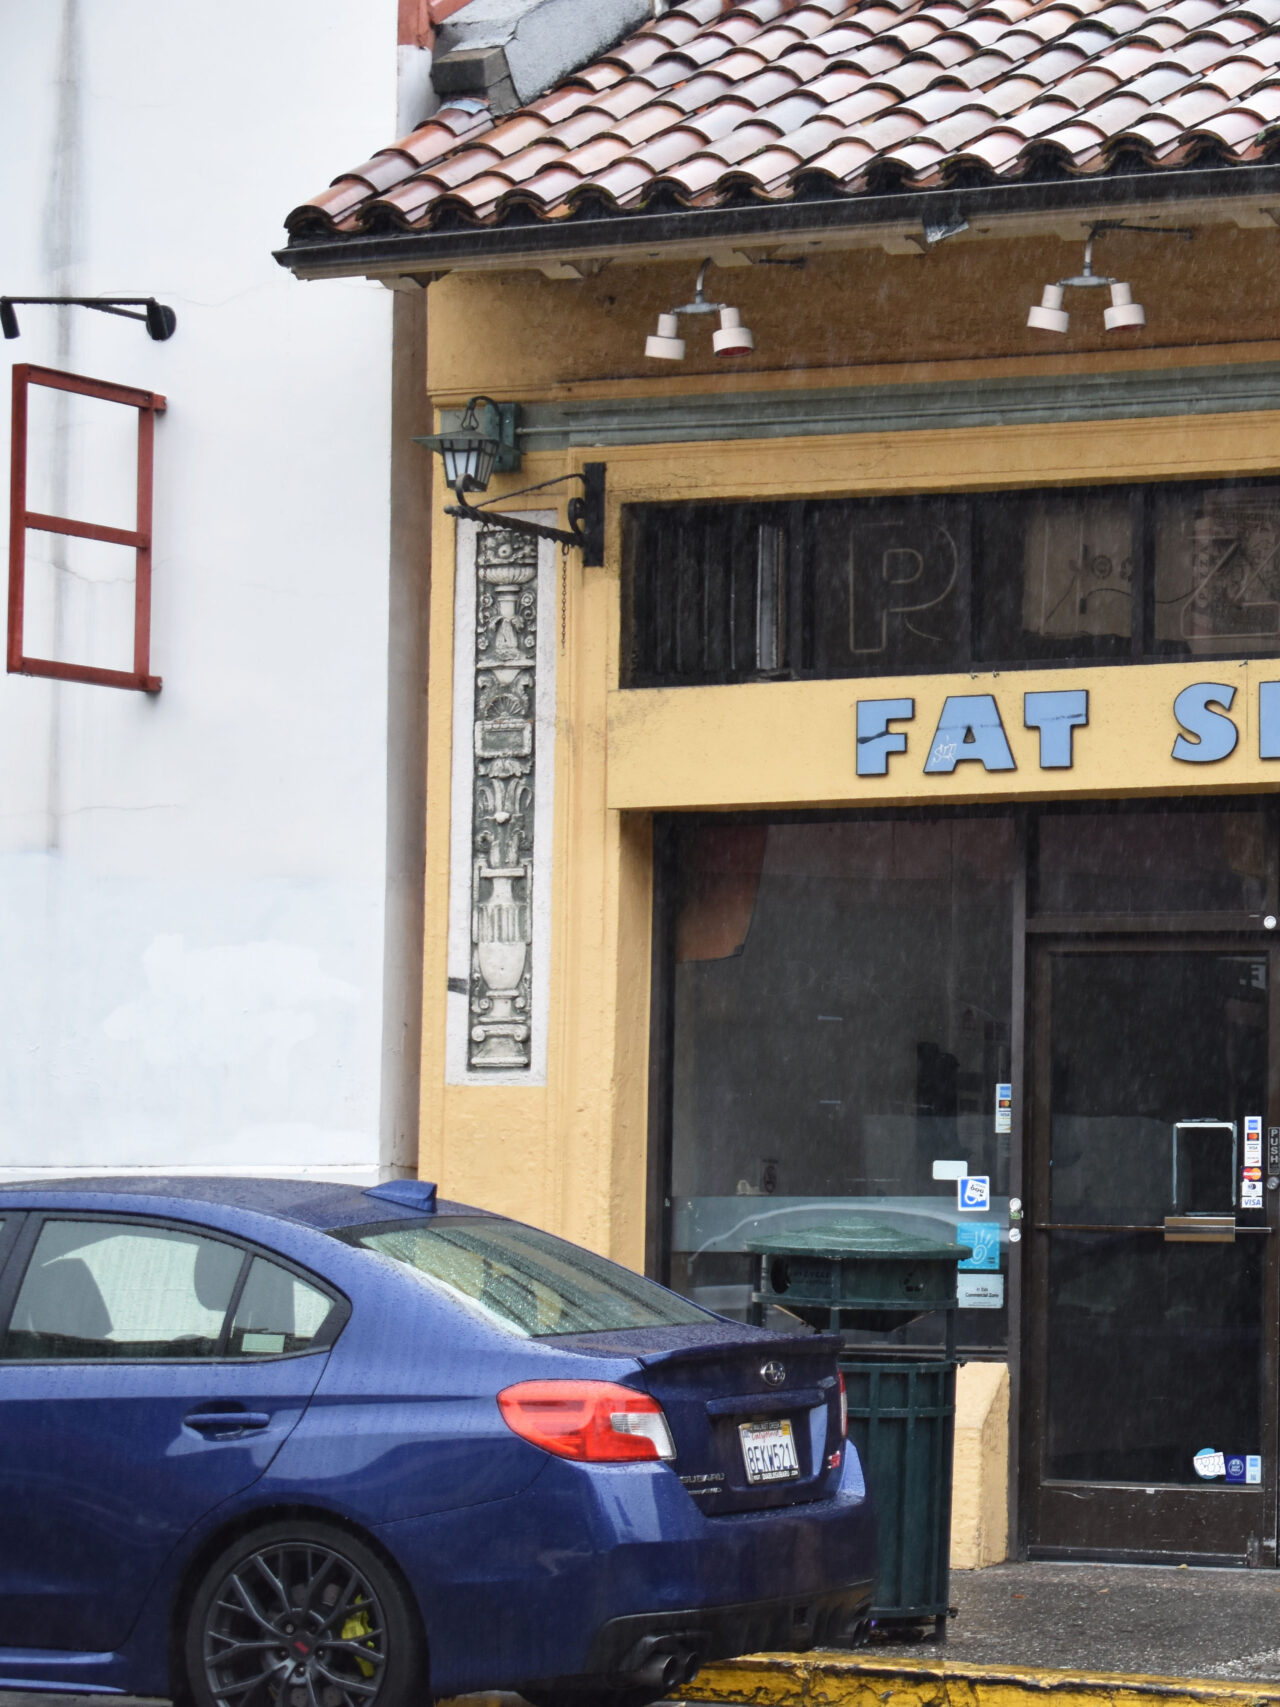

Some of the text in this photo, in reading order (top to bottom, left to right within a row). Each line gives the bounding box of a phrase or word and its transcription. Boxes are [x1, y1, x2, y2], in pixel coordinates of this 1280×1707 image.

[855, 690, 1089, 777] FAT
[1271, 1129, 1279, 1163] PUSH
[747, 1443, 795, 1473] 8EKW521
[679, 1472, 726, 1484] SUBARU
